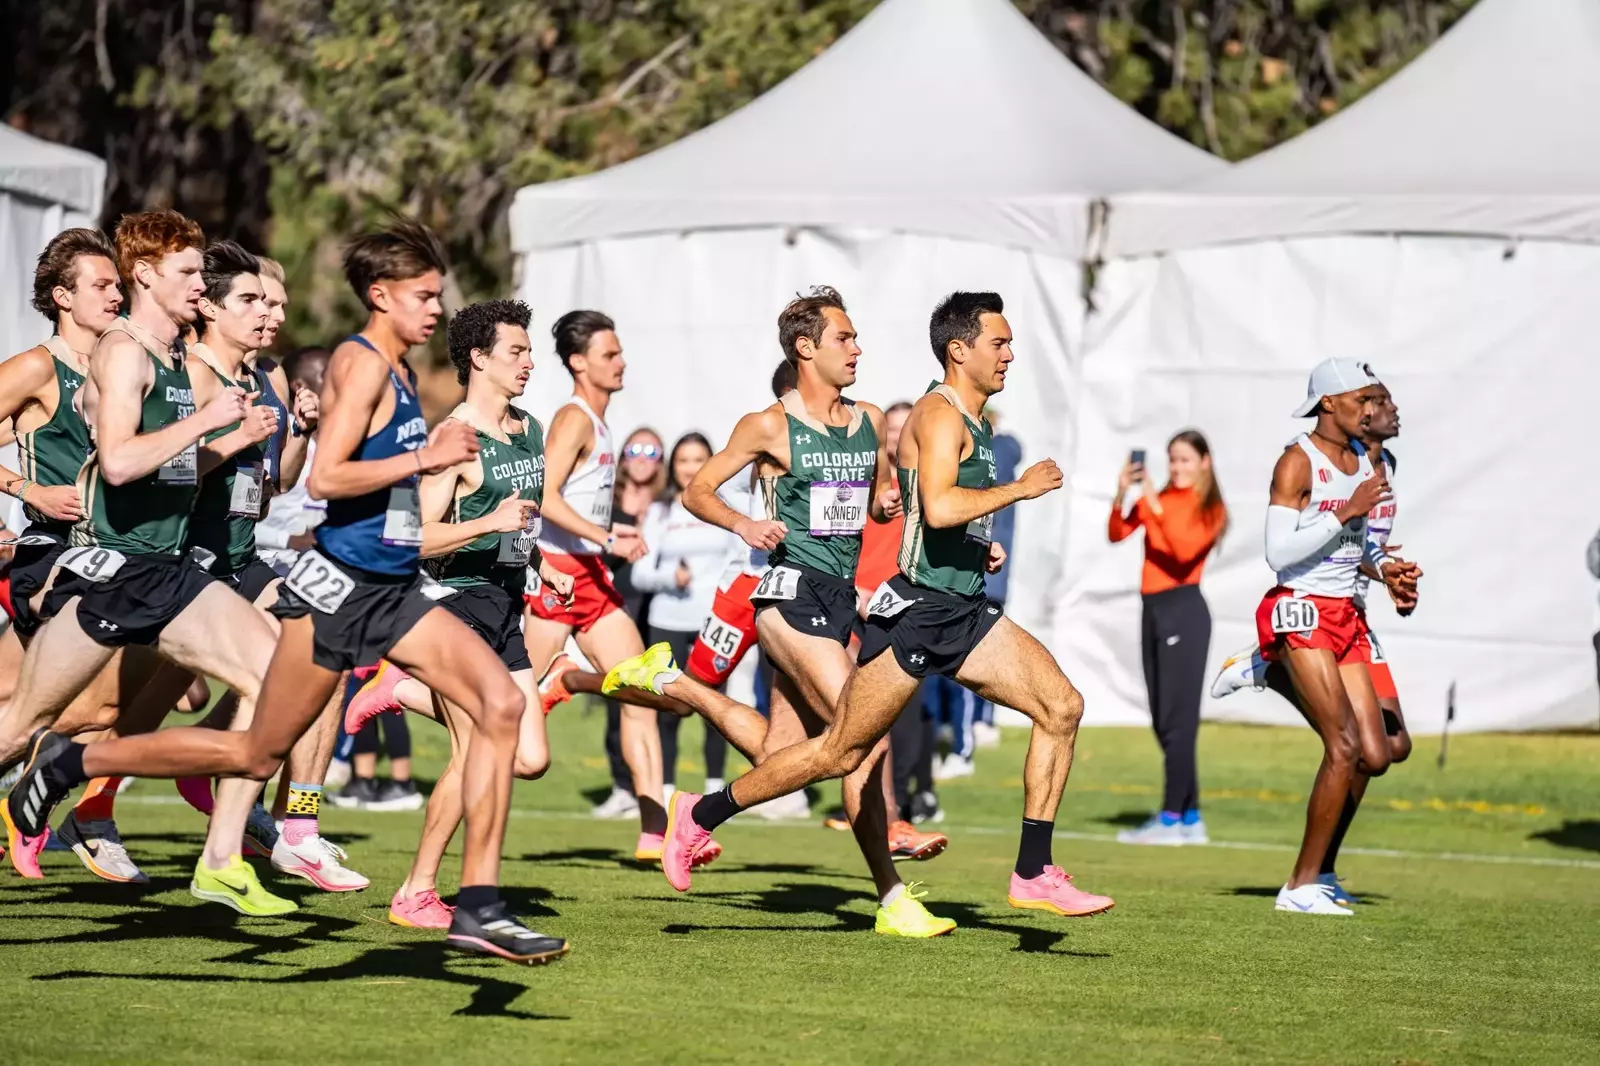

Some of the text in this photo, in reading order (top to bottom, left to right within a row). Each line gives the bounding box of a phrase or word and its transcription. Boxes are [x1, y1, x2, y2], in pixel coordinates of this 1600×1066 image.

[801, 451, 876, 468] COLORADO
[511, 472, 543, 491] STATE
[823, 468, 866, 481] STATE
[824, 505, 861, 520] KENNEDY
[290, 557, 345, 609] 122
[757, 569, 785, 597] 81
[1275, 602, 1314, 628] 150
[702, 617, 739, 655] 145
